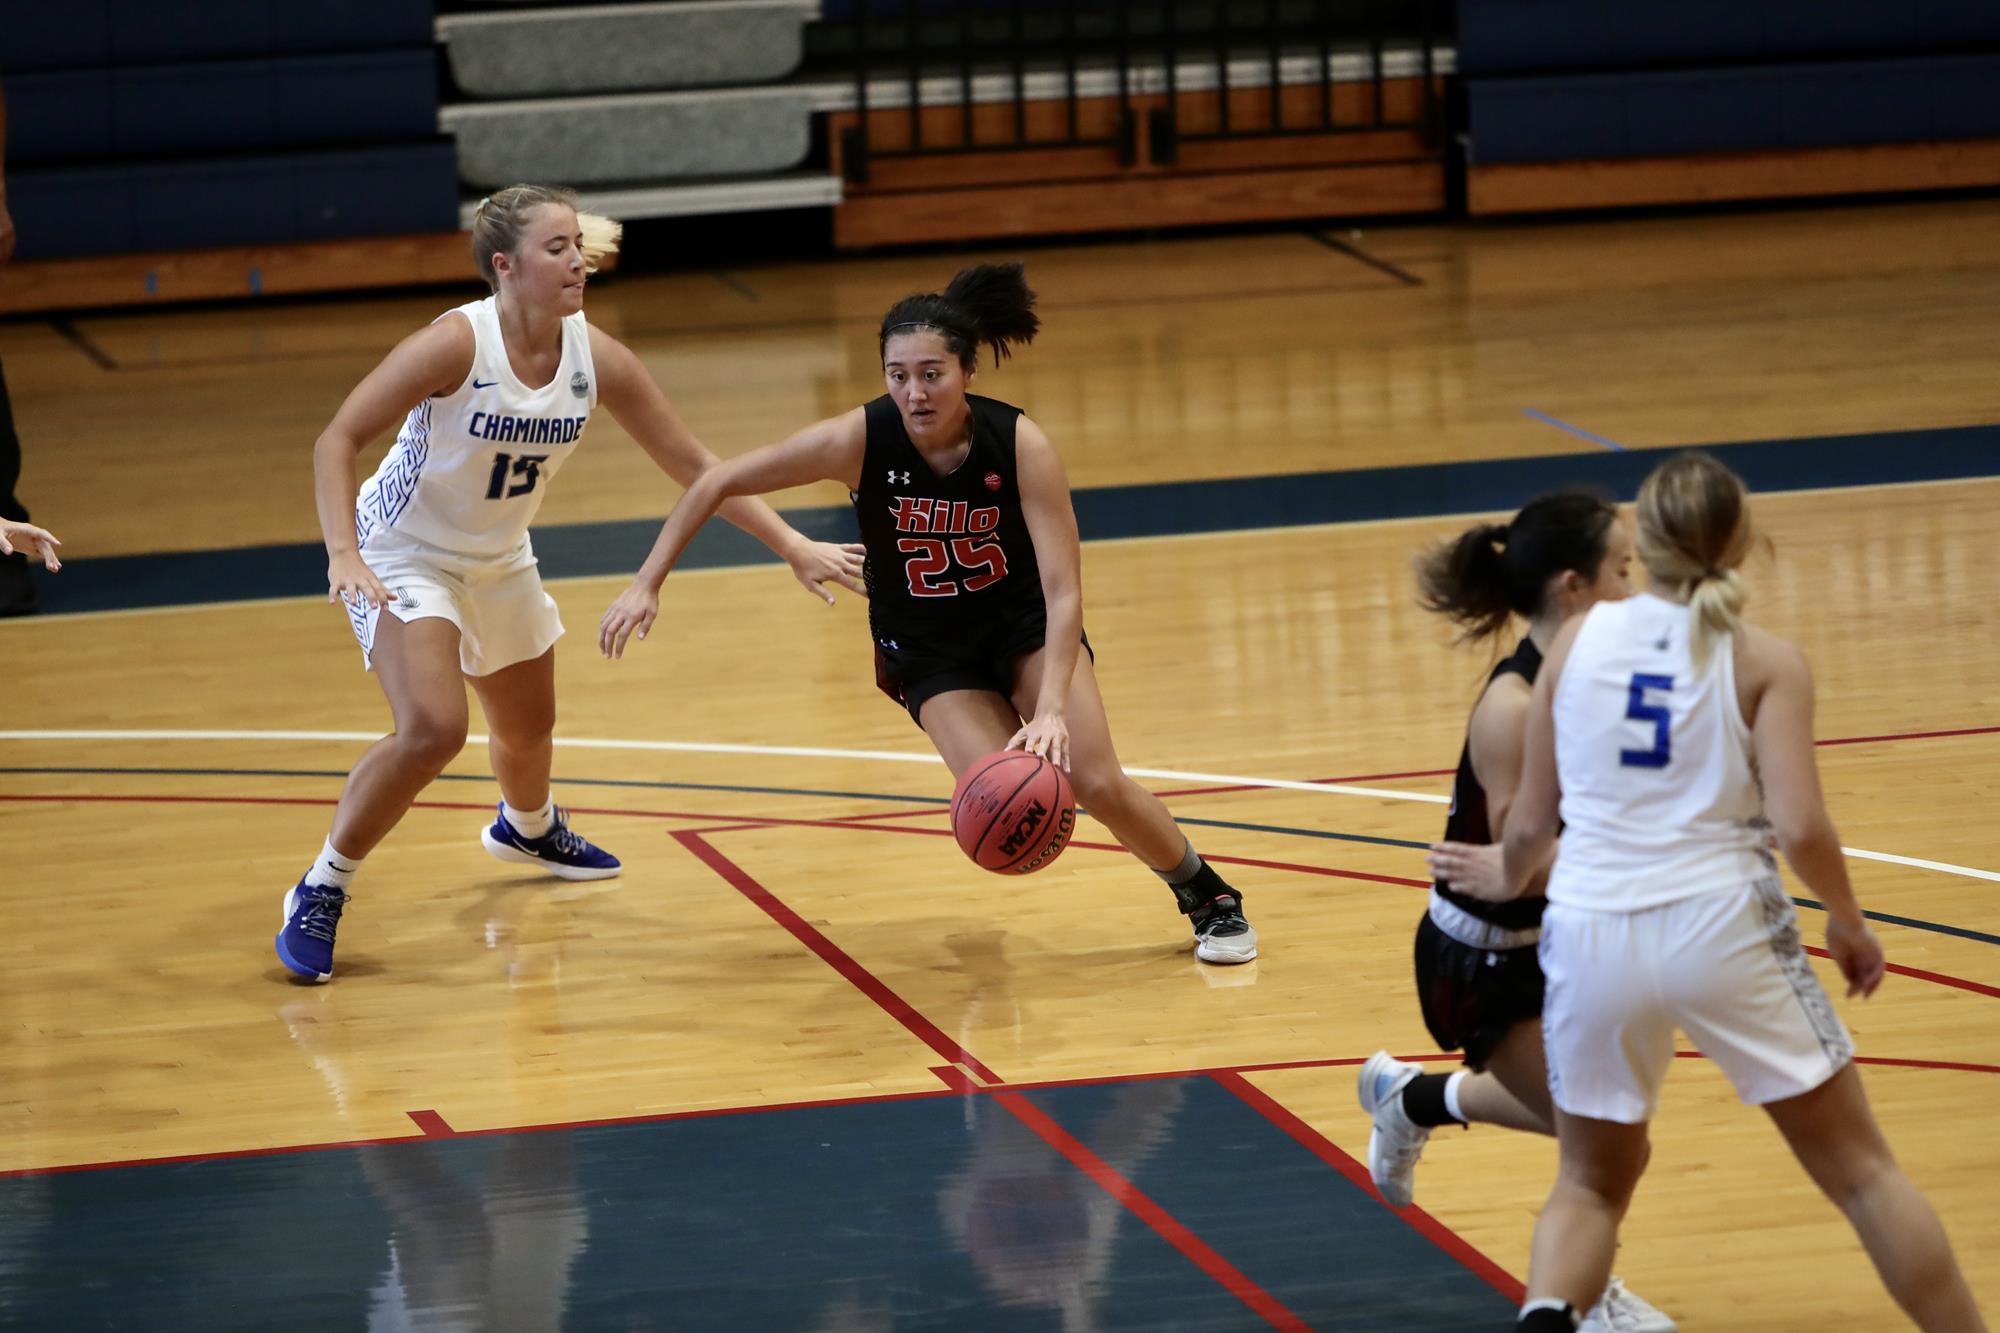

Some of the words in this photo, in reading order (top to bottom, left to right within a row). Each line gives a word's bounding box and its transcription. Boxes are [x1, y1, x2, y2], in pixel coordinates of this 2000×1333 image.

[468, 411, 586, 444] CHAMINADE
[484, 451, 550, 500] 15
[897, 532, 1009, 597] 25
[1619, 672, 1674, 769] 5
[998, 798, 1047, 857] NCAA
